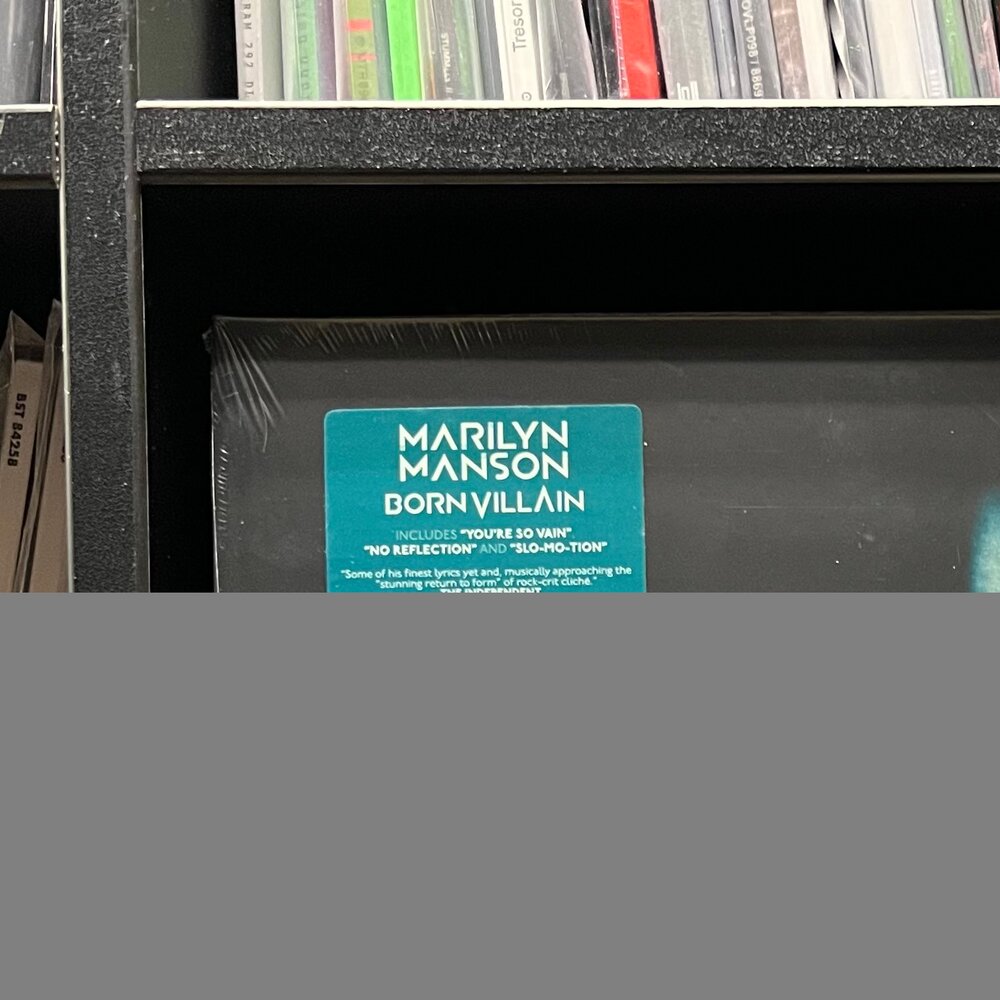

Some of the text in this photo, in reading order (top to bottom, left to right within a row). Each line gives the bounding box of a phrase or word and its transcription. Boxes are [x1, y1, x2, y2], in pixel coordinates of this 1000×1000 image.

[511, 0, 527, 53] Tresor
[244, 42, 255, 68] 292
[7, 393, 27, 467] BST 84258
[399, 420, 569, 451] MARILYN
[399, 451, 569, 482] MANSON
[384, 485, 585, 520] BORN VILLAIN
[364, 541, 608, 556] "NO REFLECTION" AND "SLO-MO-TION"
[395, 529, 457, 541] INCLUDES
[460, 528, 513, 540] "YOU'RE
[516, 528, 533, 539] SO
[341, 565, 632, 580] "Some of his finest lyrics yet and, musically approaching the
[376, 579, 423, 591] "stunning
[425, 579, 456, 589] return
[459, 579, 470, 588] to
[472, 577, 500, 588] form"
[503, 577, 515, 586] of
[516, 577, 559, 587] rock-crit
